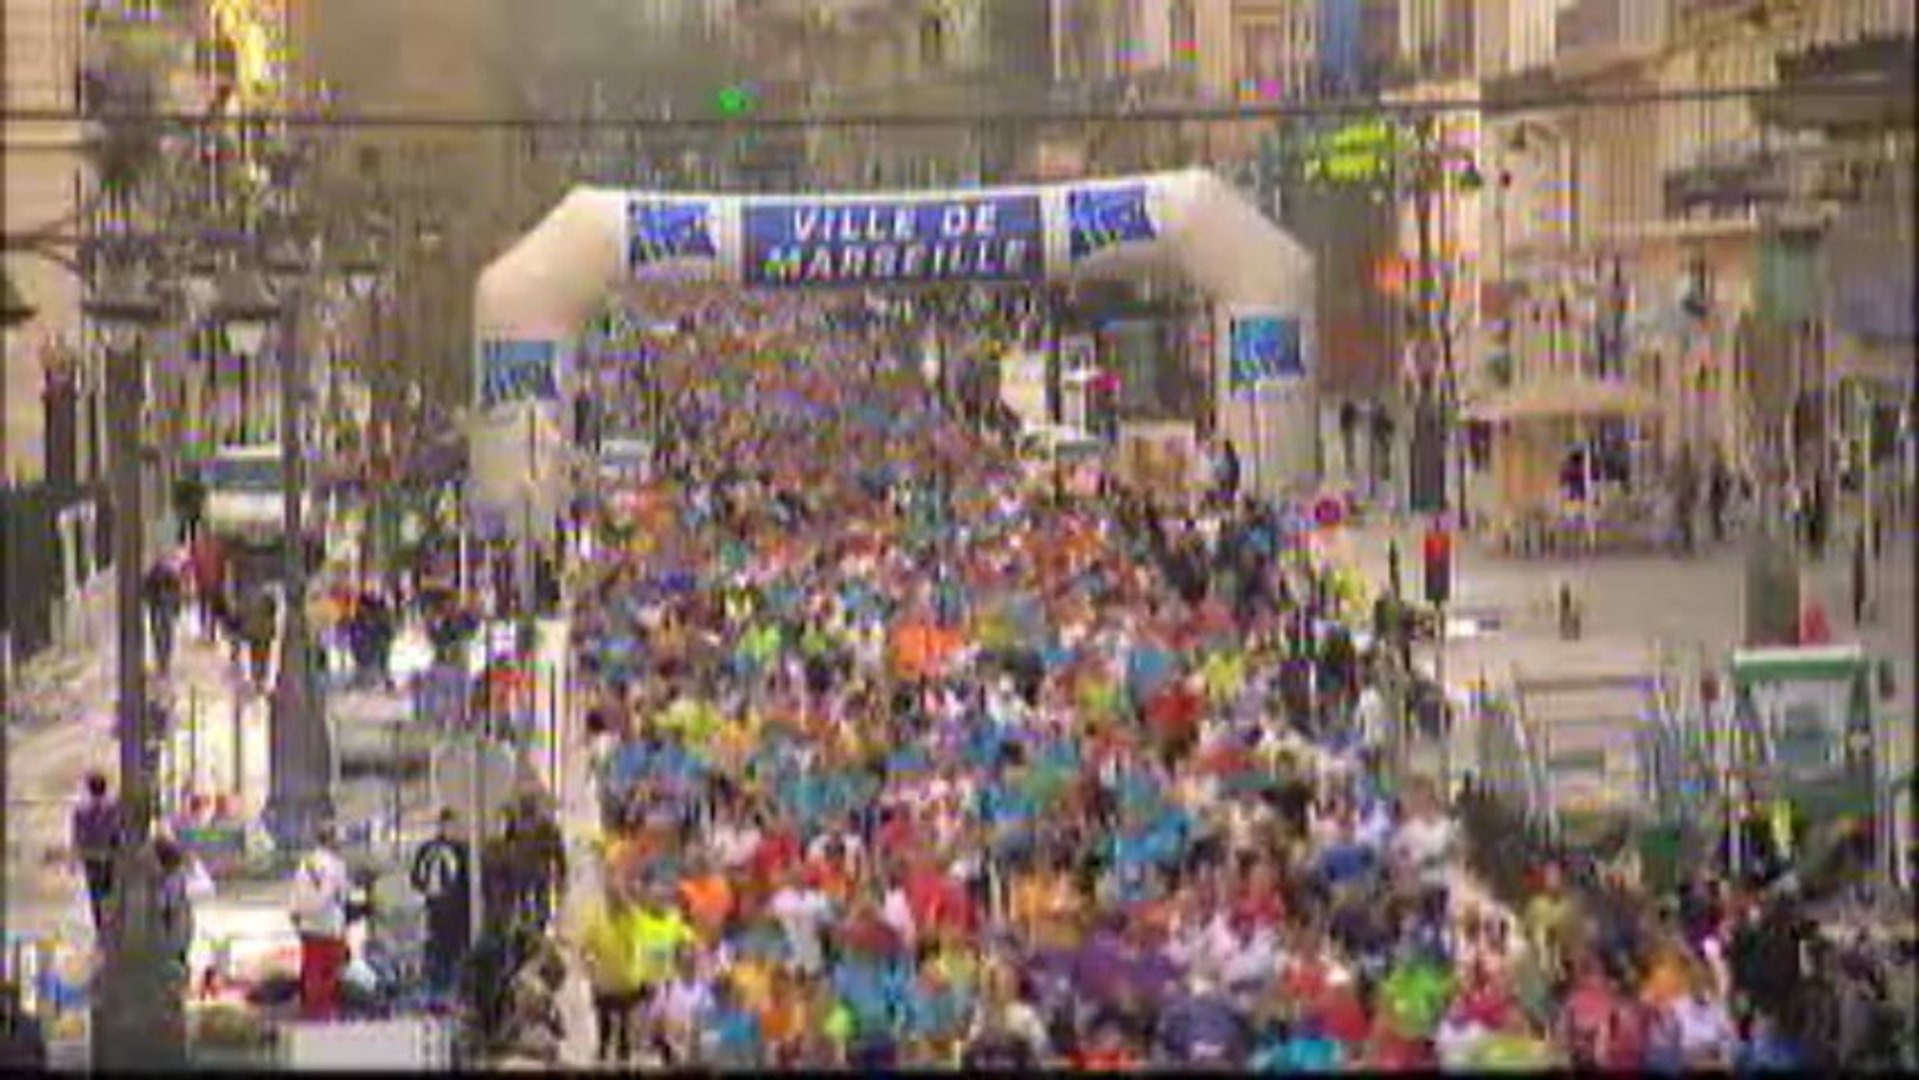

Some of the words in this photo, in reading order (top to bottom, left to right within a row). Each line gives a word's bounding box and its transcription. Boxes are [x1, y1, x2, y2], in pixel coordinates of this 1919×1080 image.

[793, 204, 915, 241] VILLE
[941, 201, 998, 237] DE
[762, 239, 1028, 279] MARSEILLE
